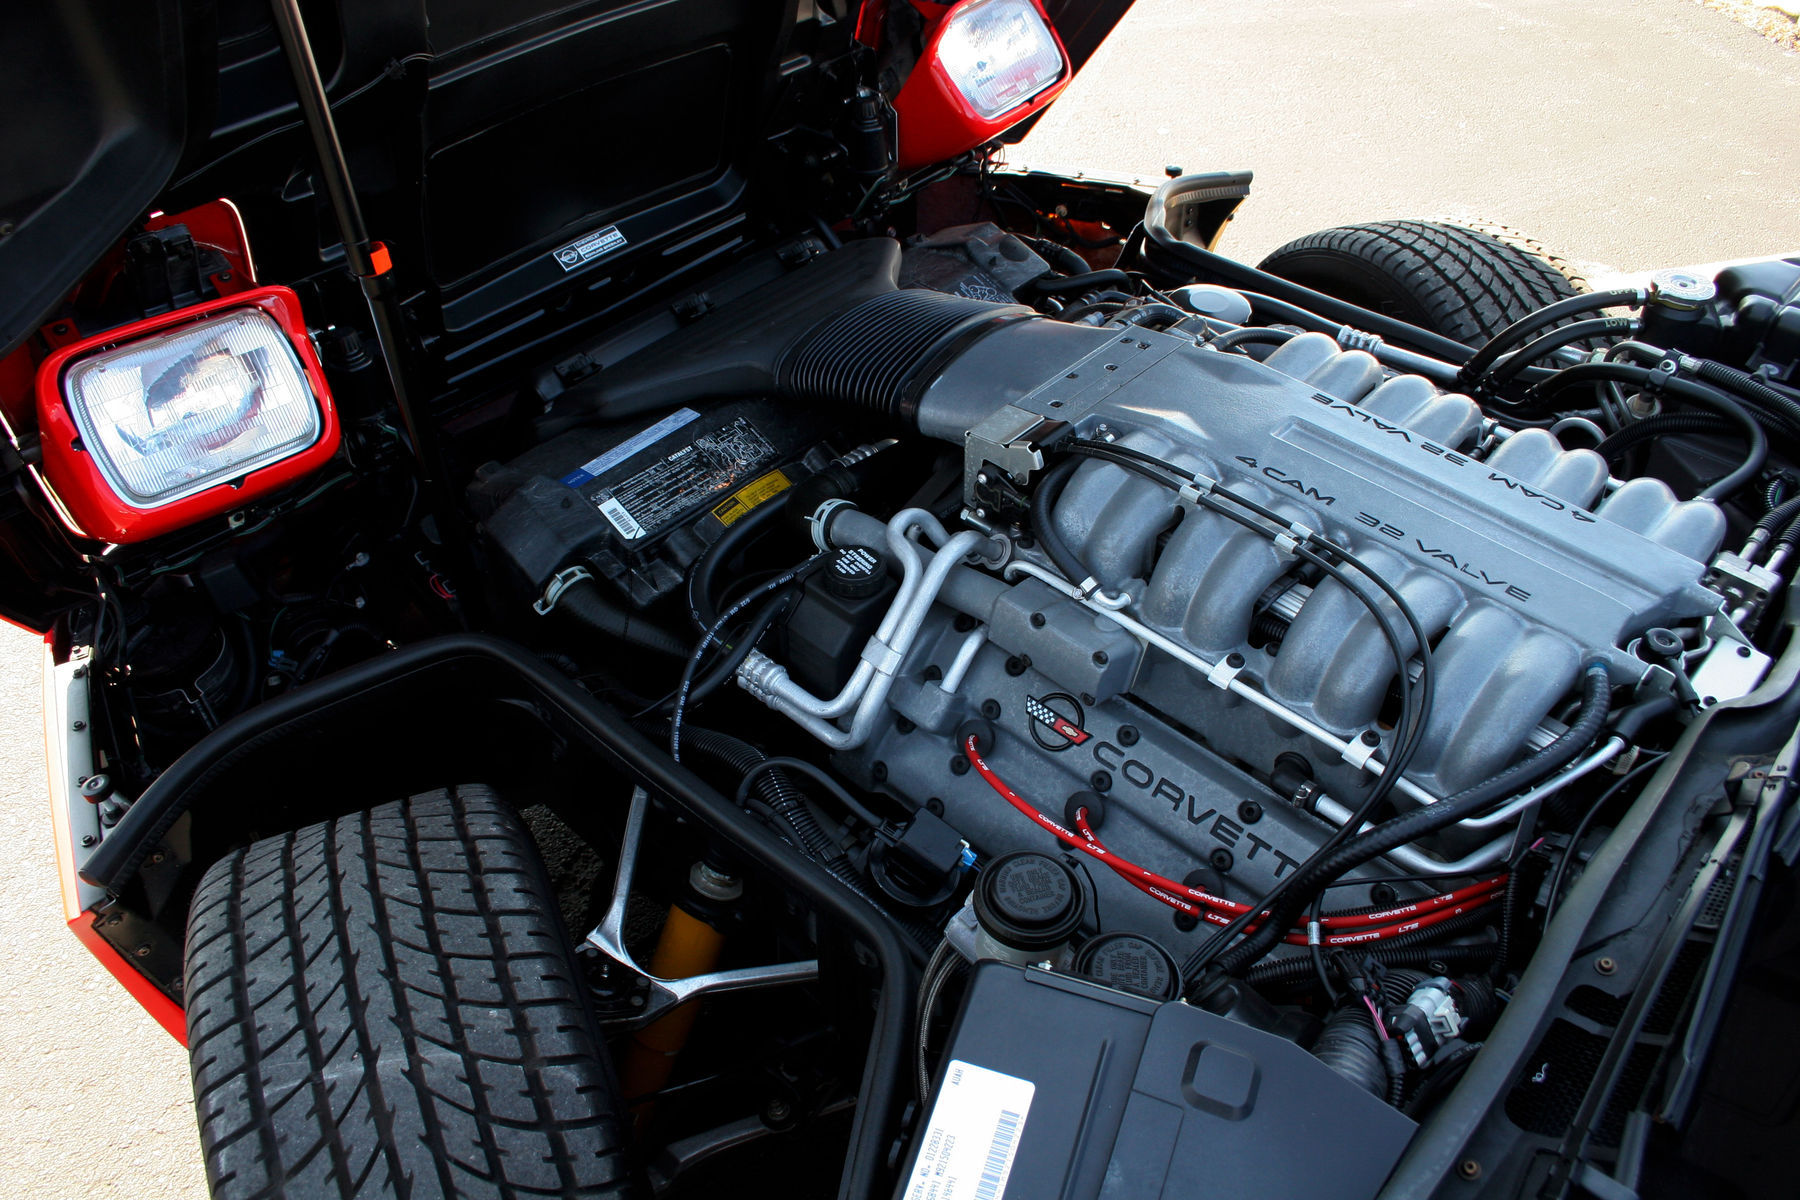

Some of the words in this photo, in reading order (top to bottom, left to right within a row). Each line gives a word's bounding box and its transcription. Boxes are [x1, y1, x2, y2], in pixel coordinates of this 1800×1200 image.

[580, 233, 618, 252] CORVETTE
[1311, 392, 1412, 443] VALVE
[668, 446, 693, 462] CATALYST
[1420, 442, 1468, 467] 32
[848, 549, 872, 569] STEERING
[857, 548, 876, 563] POWER
[1355, 511, 1405, 541] 32
[1416, 538, 1532, 603] VALVE
[1092, 741, 1300, 878] CORVETT
[1038, 813, 1075, 838] CORVETTE
[1188, 888, 1236, 908] CORVETTE
[1150, 887, 1192, 911] CORVETTE
[1368, 905, 1417, 920] CORVETTE
[1330, 932, 1380, 944] CORVETTE
